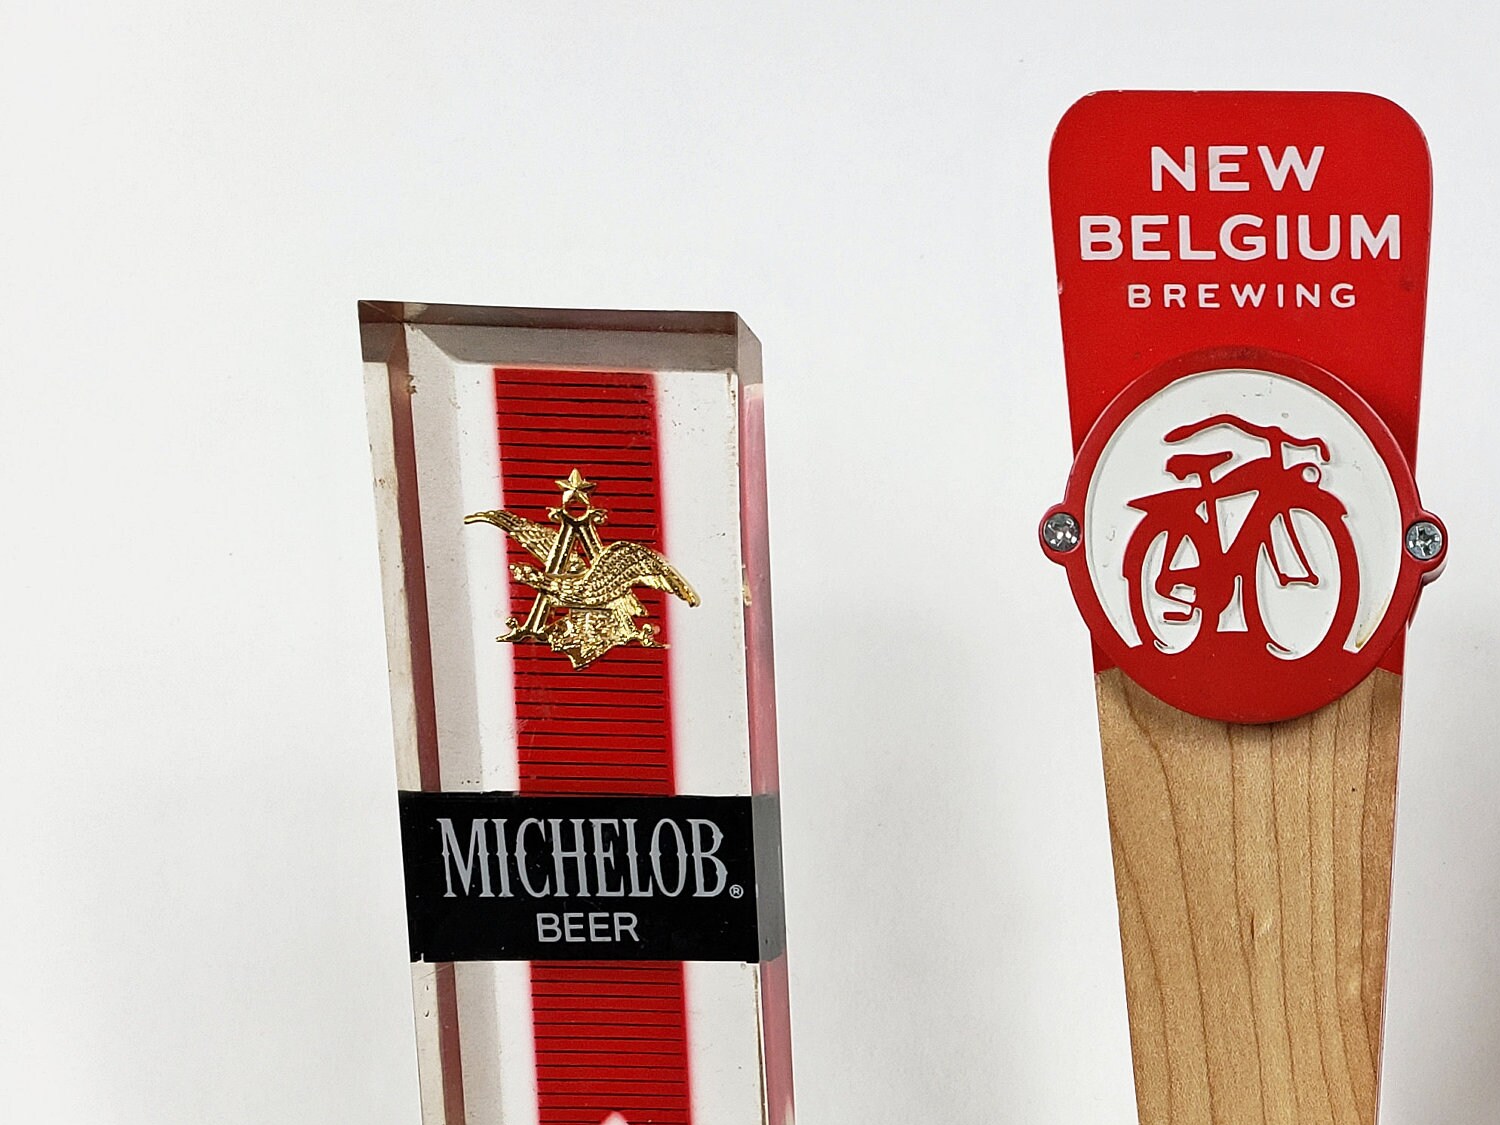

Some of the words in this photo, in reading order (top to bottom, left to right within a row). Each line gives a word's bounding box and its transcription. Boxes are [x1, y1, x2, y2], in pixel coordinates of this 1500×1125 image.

[1150, 144, 1325, 193] NEW
[1079, 213, 1401, 262] BELGIUM
[1127, 282, 1356, 309] BREWING
[436, 817, 729, 898] MICHELOB
[536, 912, 640, 943] BEER
